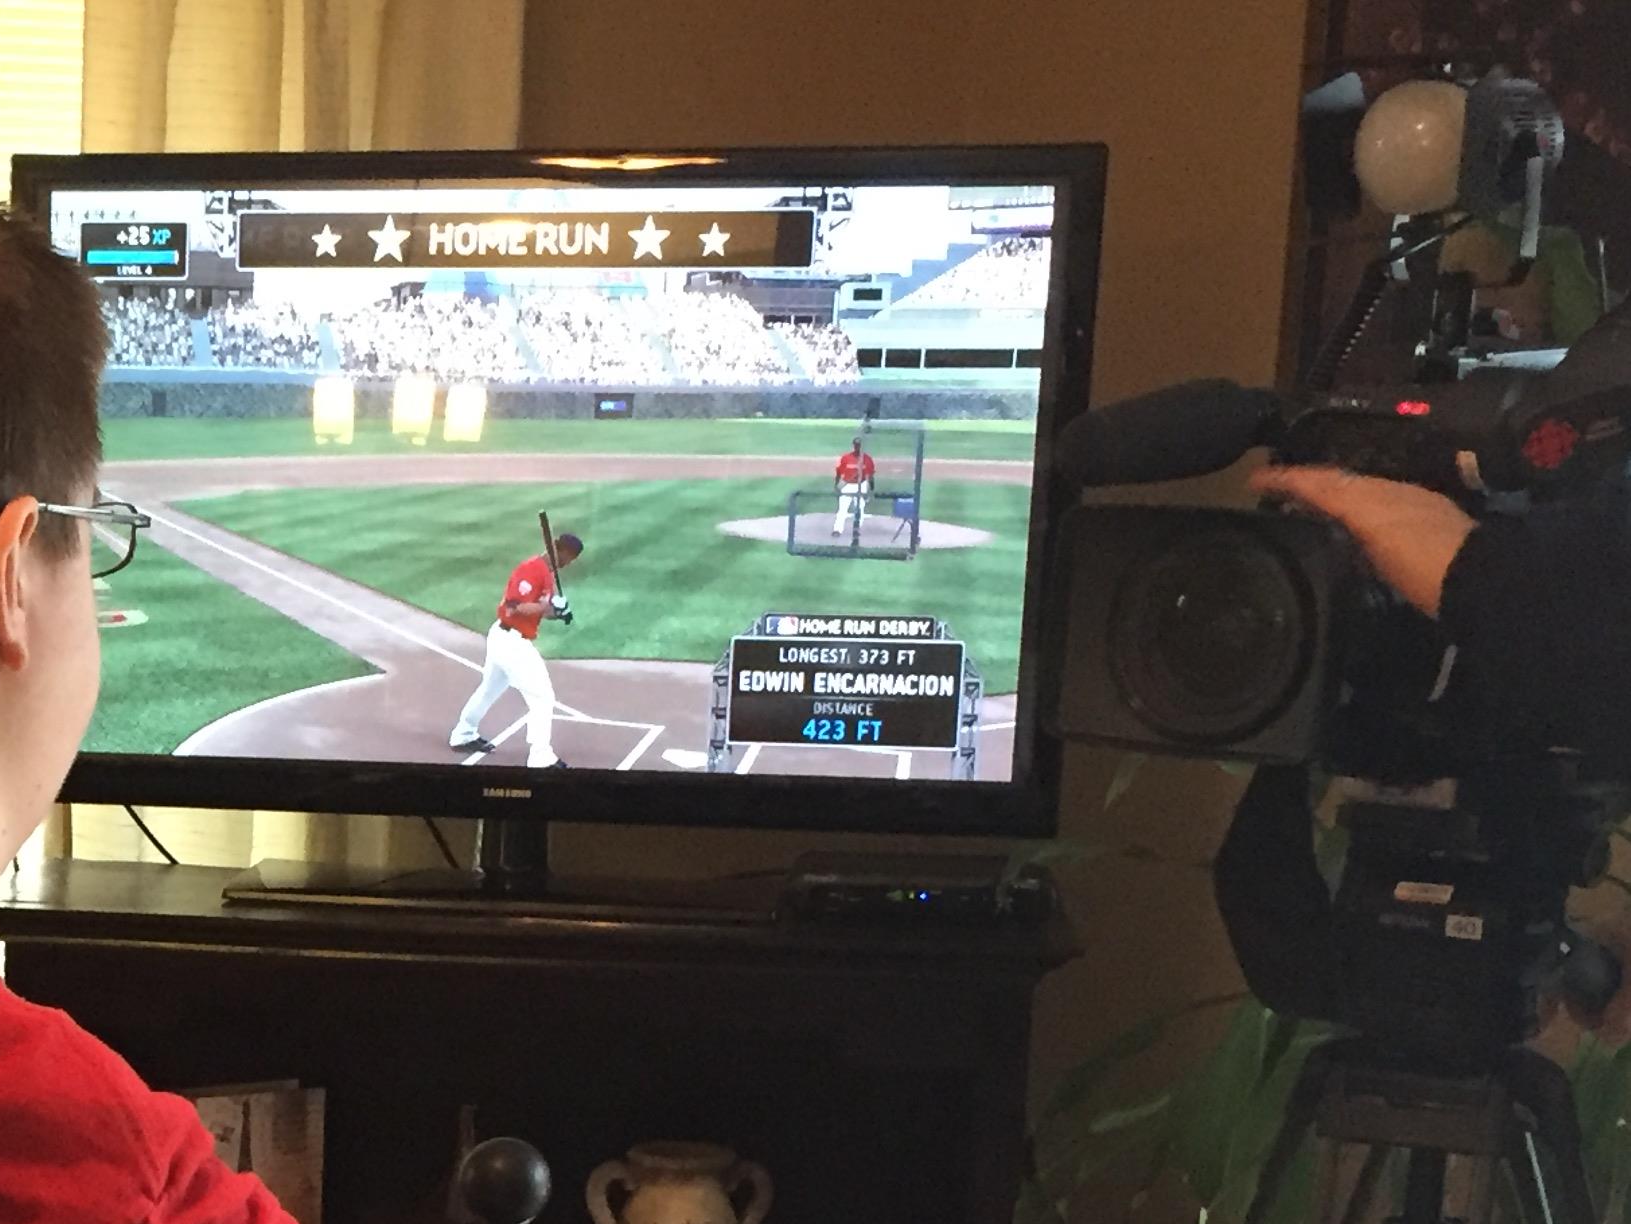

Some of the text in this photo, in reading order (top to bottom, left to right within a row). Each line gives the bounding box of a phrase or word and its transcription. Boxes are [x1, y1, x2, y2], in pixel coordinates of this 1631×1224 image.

[116, 225, 171, 246] +25 XP
[429, 221, 609, 255] HOME RUN
[117, 265, 142, 276] LEVEL
[799, 618, 842, 635] HOME
[843, 618, 876, 636] RUN
[859, 649, 889, 665] 373
[896, 650, 916, 666] FT
[739, 670, 954, 697] EDWIN ENCARNACION
[813, 701, 873, 717] DISTANCE
[803, 719, 882, 742] 423 FT
